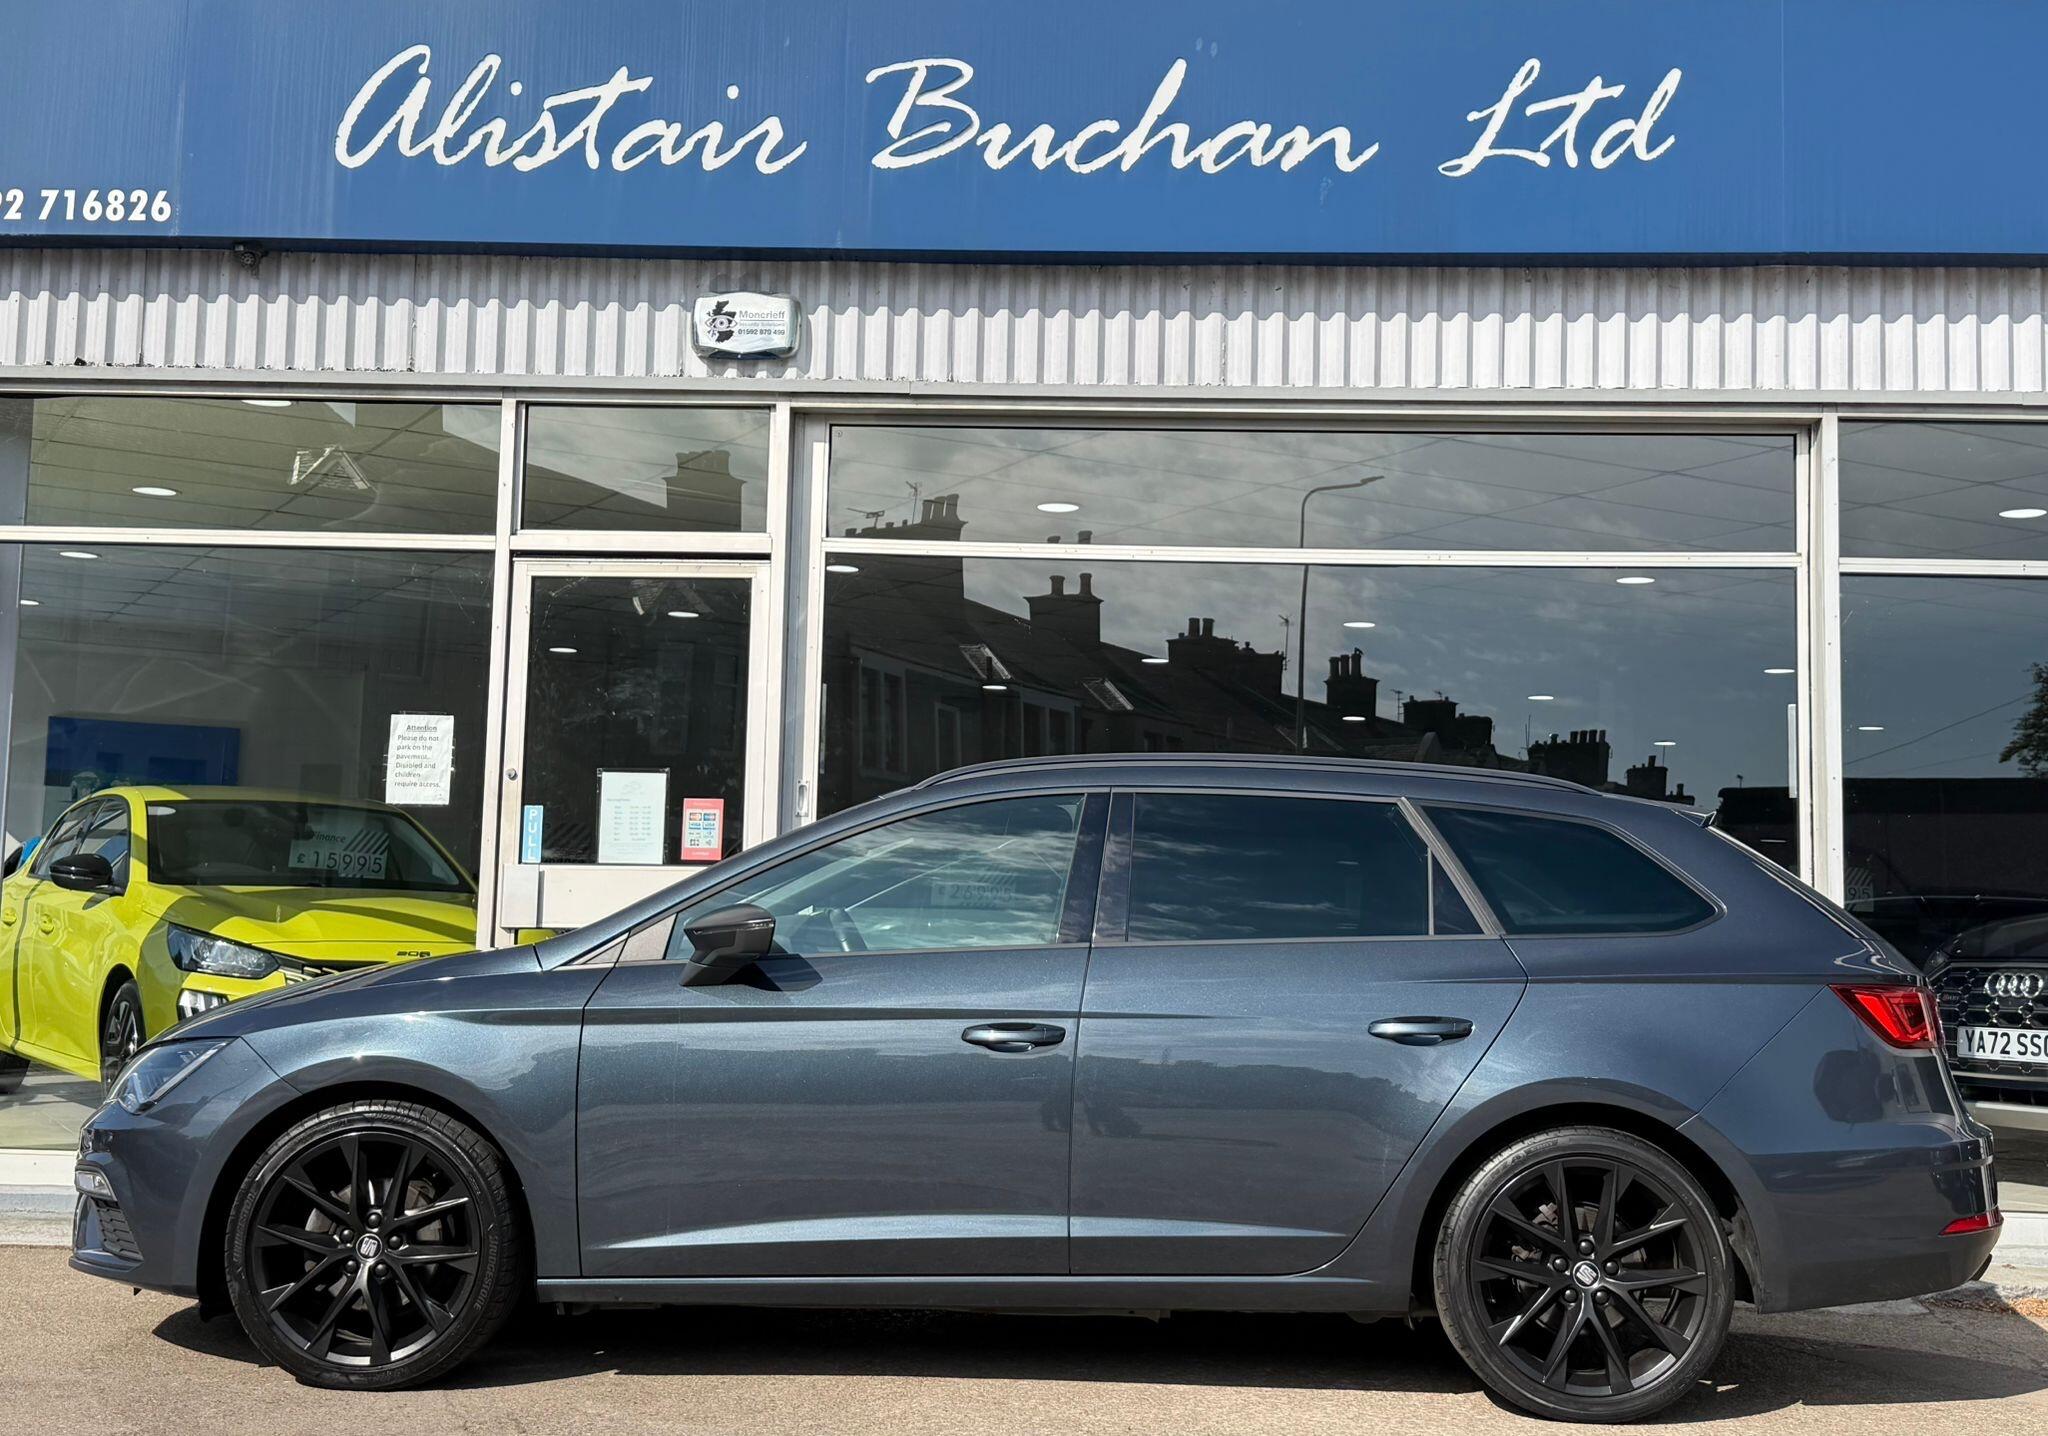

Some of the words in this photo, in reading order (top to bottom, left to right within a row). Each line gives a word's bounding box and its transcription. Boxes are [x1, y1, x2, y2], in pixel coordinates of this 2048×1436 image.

[334, 44, 807, 174] Alistair
[865, 57, 1380, 174] Buchan
[1437, 57, 1682, 177] Ltd
[0, 188, 24, 220] 2
[38, 188, 172, 222] 716826
[739, 310, 786, 319] Moncrieff
[527, 808, 538, 860] PULL
[1964, 1029, 2011, 1056] YA72
[2016, 1032, 2048, 1057] SS
